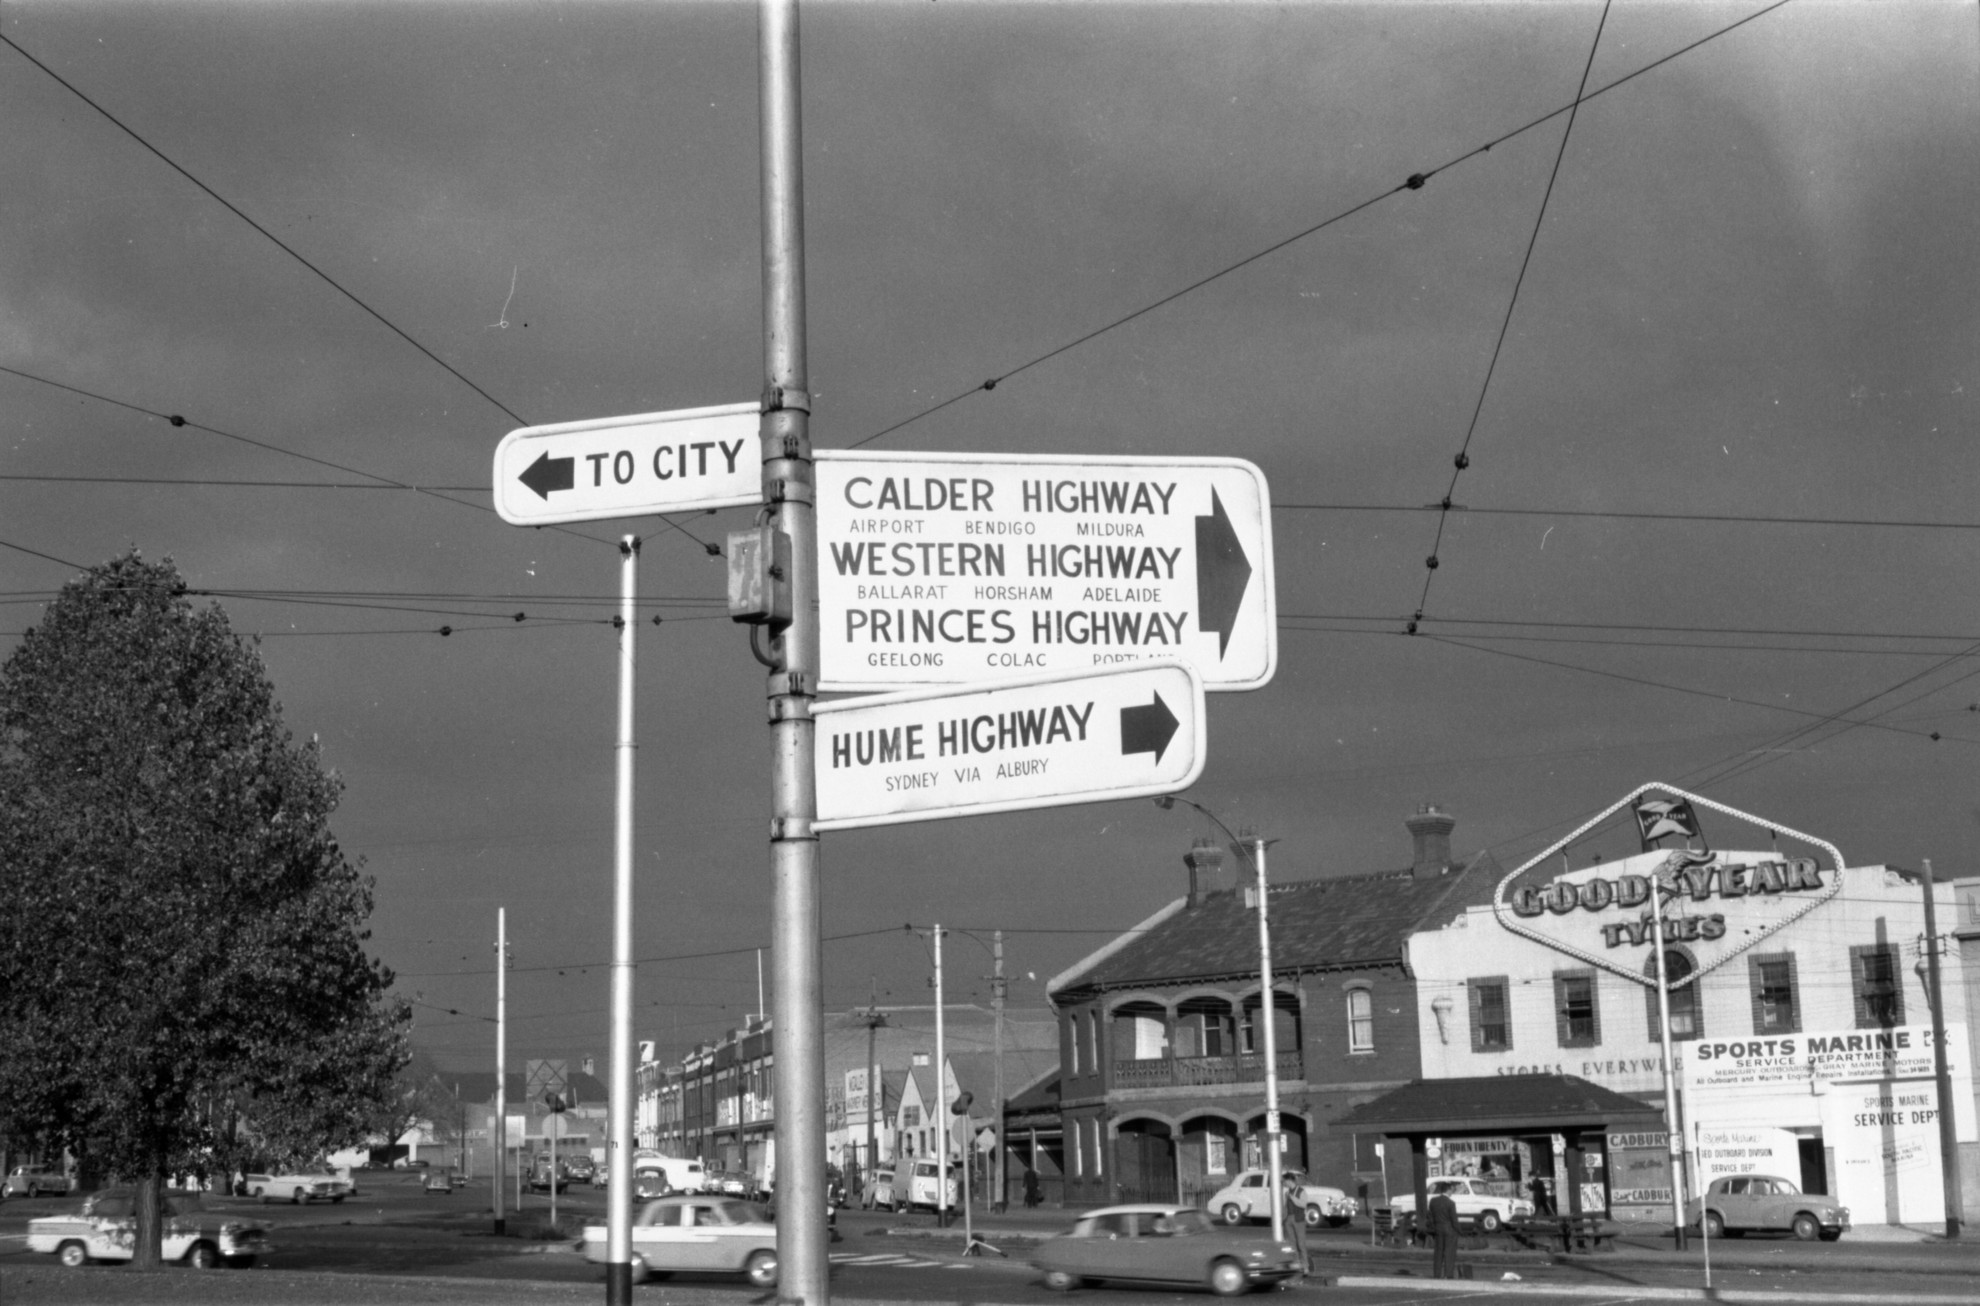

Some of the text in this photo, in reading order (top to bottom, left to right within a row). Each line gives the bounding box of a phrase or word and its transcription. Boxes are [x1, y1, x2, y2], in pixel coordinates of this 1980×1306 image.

[586, 438, 745, 485] TO CITY
[844, 476, 1178, 515] CALDER HIGHWAY
[850, 519, 1145, 537] AIRPORT BENDIGO MILDURA
[829, 542, 1183, 580] WESTERN HIGHWAY
[857, 585, 1162, 602] BALLARAT HORSHAM ADELAIDE
[846, 609, 1189, 645] PRINCES HIGHWAY
[868, 653, 944, 667] GEELONG
[986, 653, 1047, 667] COLAC
[832, 701, 1095, 769] HUME HIGHWAY
[885, 758, 1049, 791] SYDNEY VIA ALBURY
[1512, 857, 1824, 918] GOOD YEAR
[1697, 1032, 1911, 1060] SPORTS MARINE
[1736, 1050, 1899, 1068] SERVICE DEPARTMENT
[1851, 1060, 1887, 1068] MARINE
[1894, 1058, 1931, 1066] MOTORS
[1864, 1094, 1929, 1108] SPORTS MARINE
[1854, 1112, 1904, 1127] SERVICE
[1610, 1133, 1669, 1147] CADBURY
[1711, 1163, 1756, 1173] SERVICE DEPT
[1632, 1189, 1671, 1201] CADBUR
